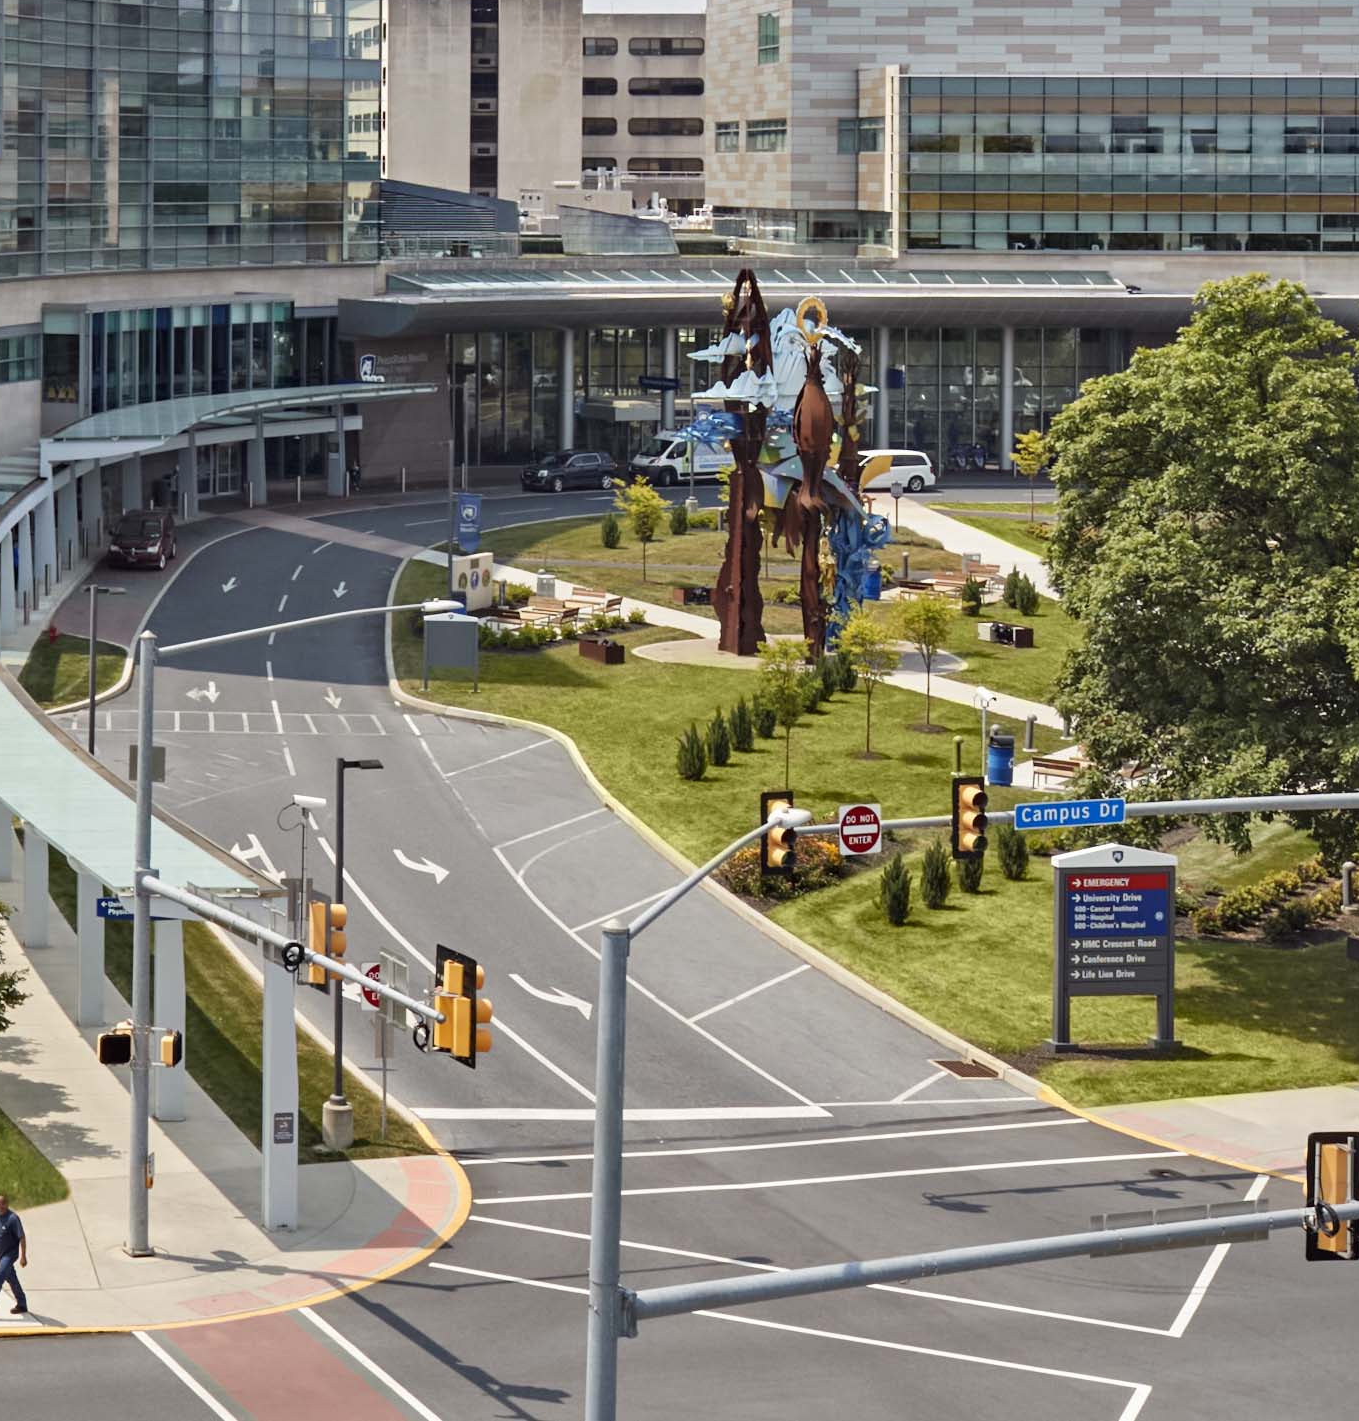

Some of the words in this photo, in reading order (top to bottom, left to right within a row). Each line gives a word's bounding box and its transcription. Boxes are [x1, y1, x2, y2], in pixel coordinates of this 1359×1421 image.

[1022, 806, 1090, 824] Campus
[1099, 803, 1119, 818] Dr
[846, 815, 857, 824] DO
[860, 814, 874, 823] NOT
[848, 835, 873, 845] ENTER
[1083, 877, 1130, 888] EMERGENCY
[1083, 893, 1120, 903] University
[1122, 892, 1142, 902] Drive
[1082, 939, 1101, 949] HMC
[1102, 939, 1136, 949] Crescent
[1137, 938, 1157, 948] Road
[1082, 955, 1124, 964] Conference
[1126, 954, 1146, 963] Drive
[1082, 970, 1096, 979] Life
[1098, 970, 1114, 978] Lion
[1116, 969, 1136, 978] Drive
